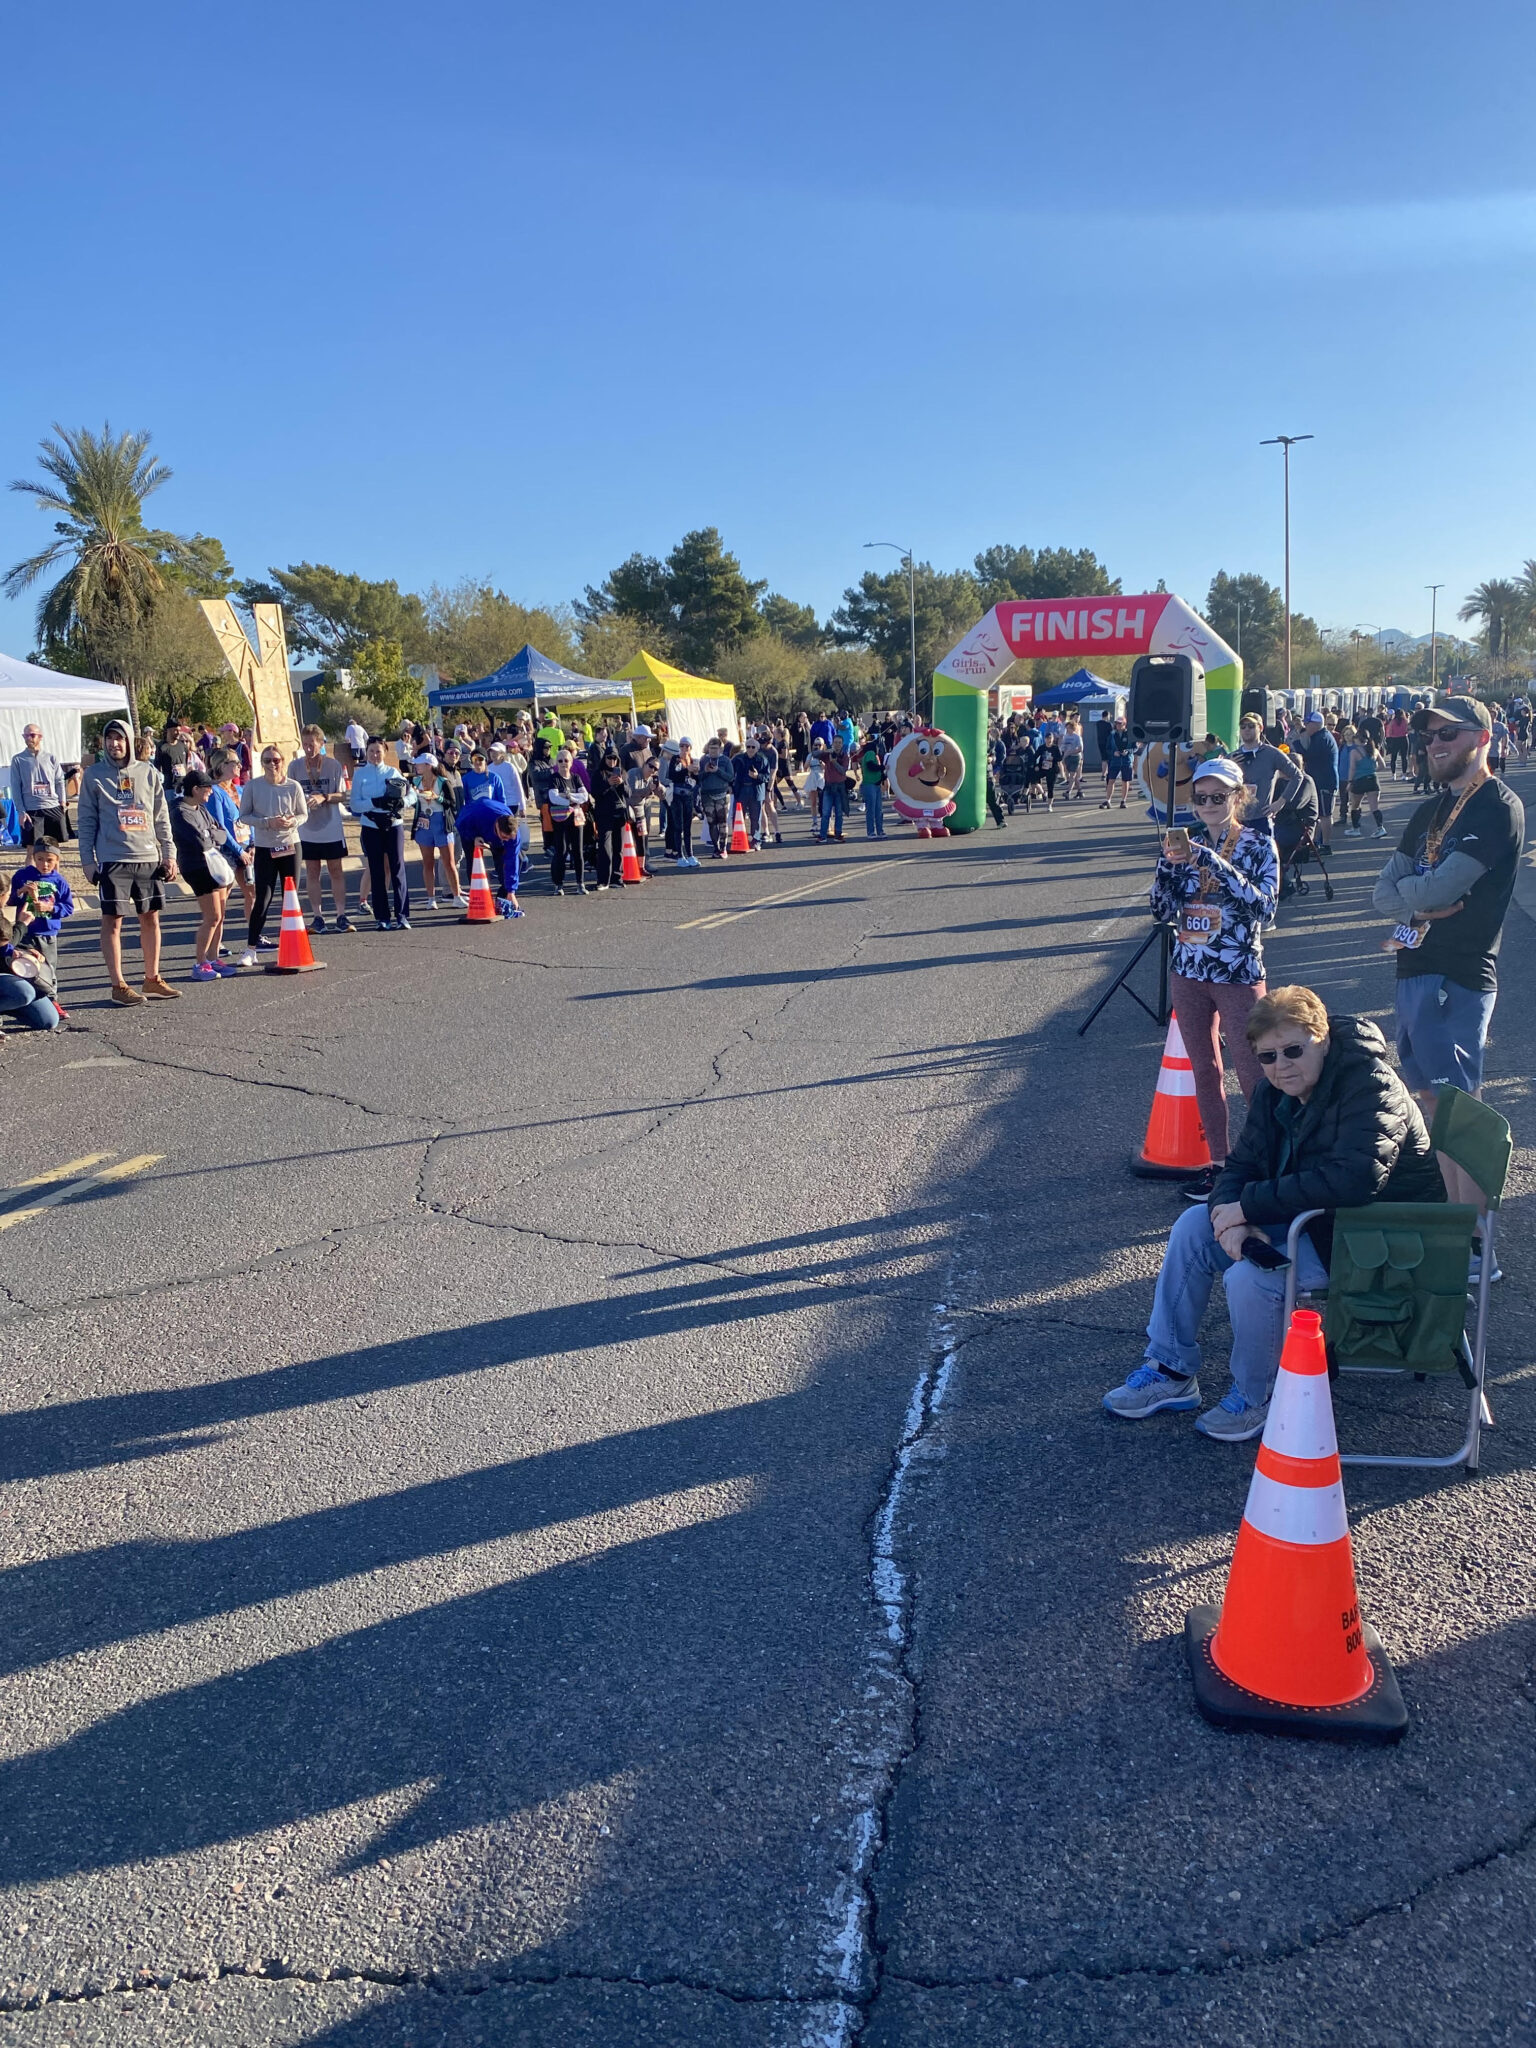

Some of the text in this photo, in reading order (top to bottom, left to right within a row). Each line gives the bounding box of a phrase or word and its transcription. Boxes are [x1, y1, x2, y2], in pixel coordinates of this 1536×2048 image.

[1011, 608, 1145, 642] FINISH
[952, 658, 978, 668] Girls
[965, 667, 987, 675] run
[439, 686, 524, 702] www.endurancerehab.com
[121, 816, 145, 825] 1545
[1186, 916, 1211, 931] 660
[1392, 923, 1419, 945] 1390
